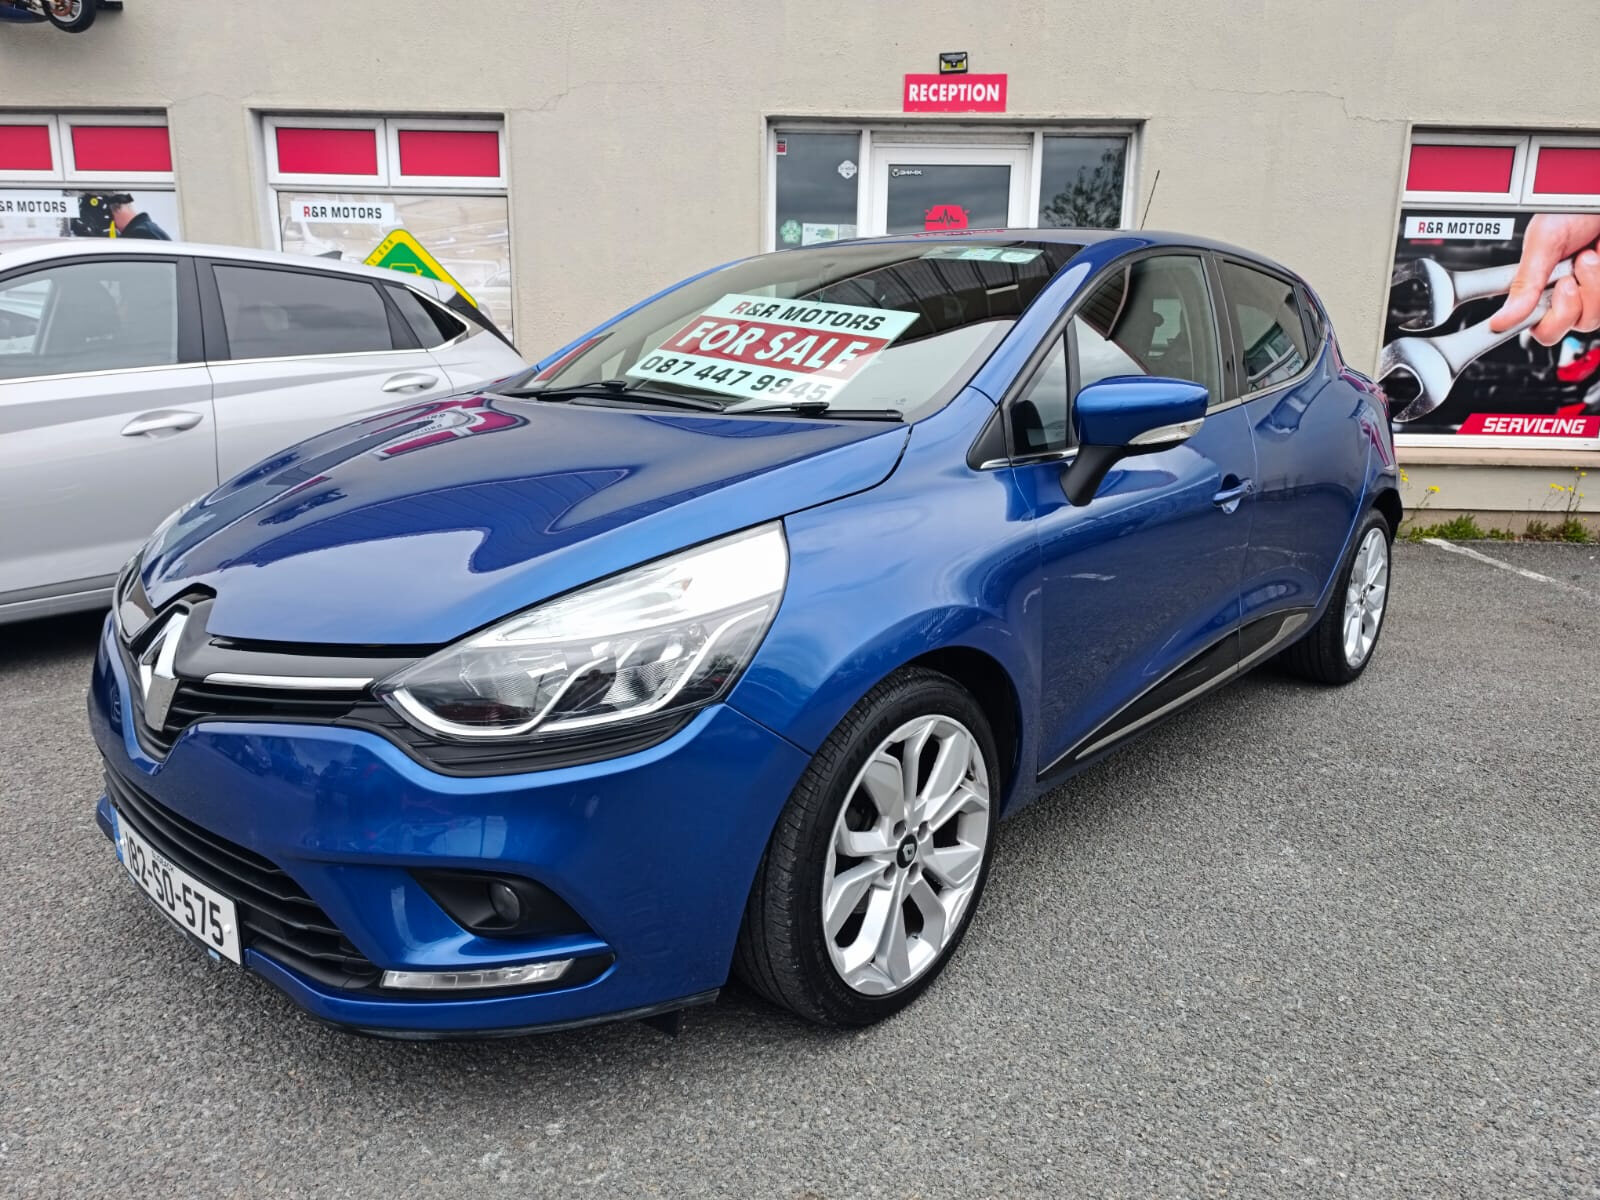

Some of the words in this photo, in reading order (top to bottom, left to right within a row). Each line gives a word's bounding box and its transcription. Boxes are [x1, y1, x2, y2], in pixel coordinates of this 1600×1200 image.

[908, 83, 1000, 102] RECEPTION
[17, 200, 67, 213] MOTORS
[303, 206, 327, 218] R&R
[331, 206, 382, 219] MOTORS
[1418, 221, 1443, 233] R&R
[1447, 222, 1501, 234] MOTORS
[729, 301, 781, 318] R&R
[778, 305, 886, 332] MOTORS
[675, 320, 766, 357] FOR
[754, 330, 868, 373] SALE
[639, 355, 693, 376] 087
[695, 364, 753, 387] 447
[750, 374, 835, 402] 9945
[1481, 417, 1587, 435] SERVICING
